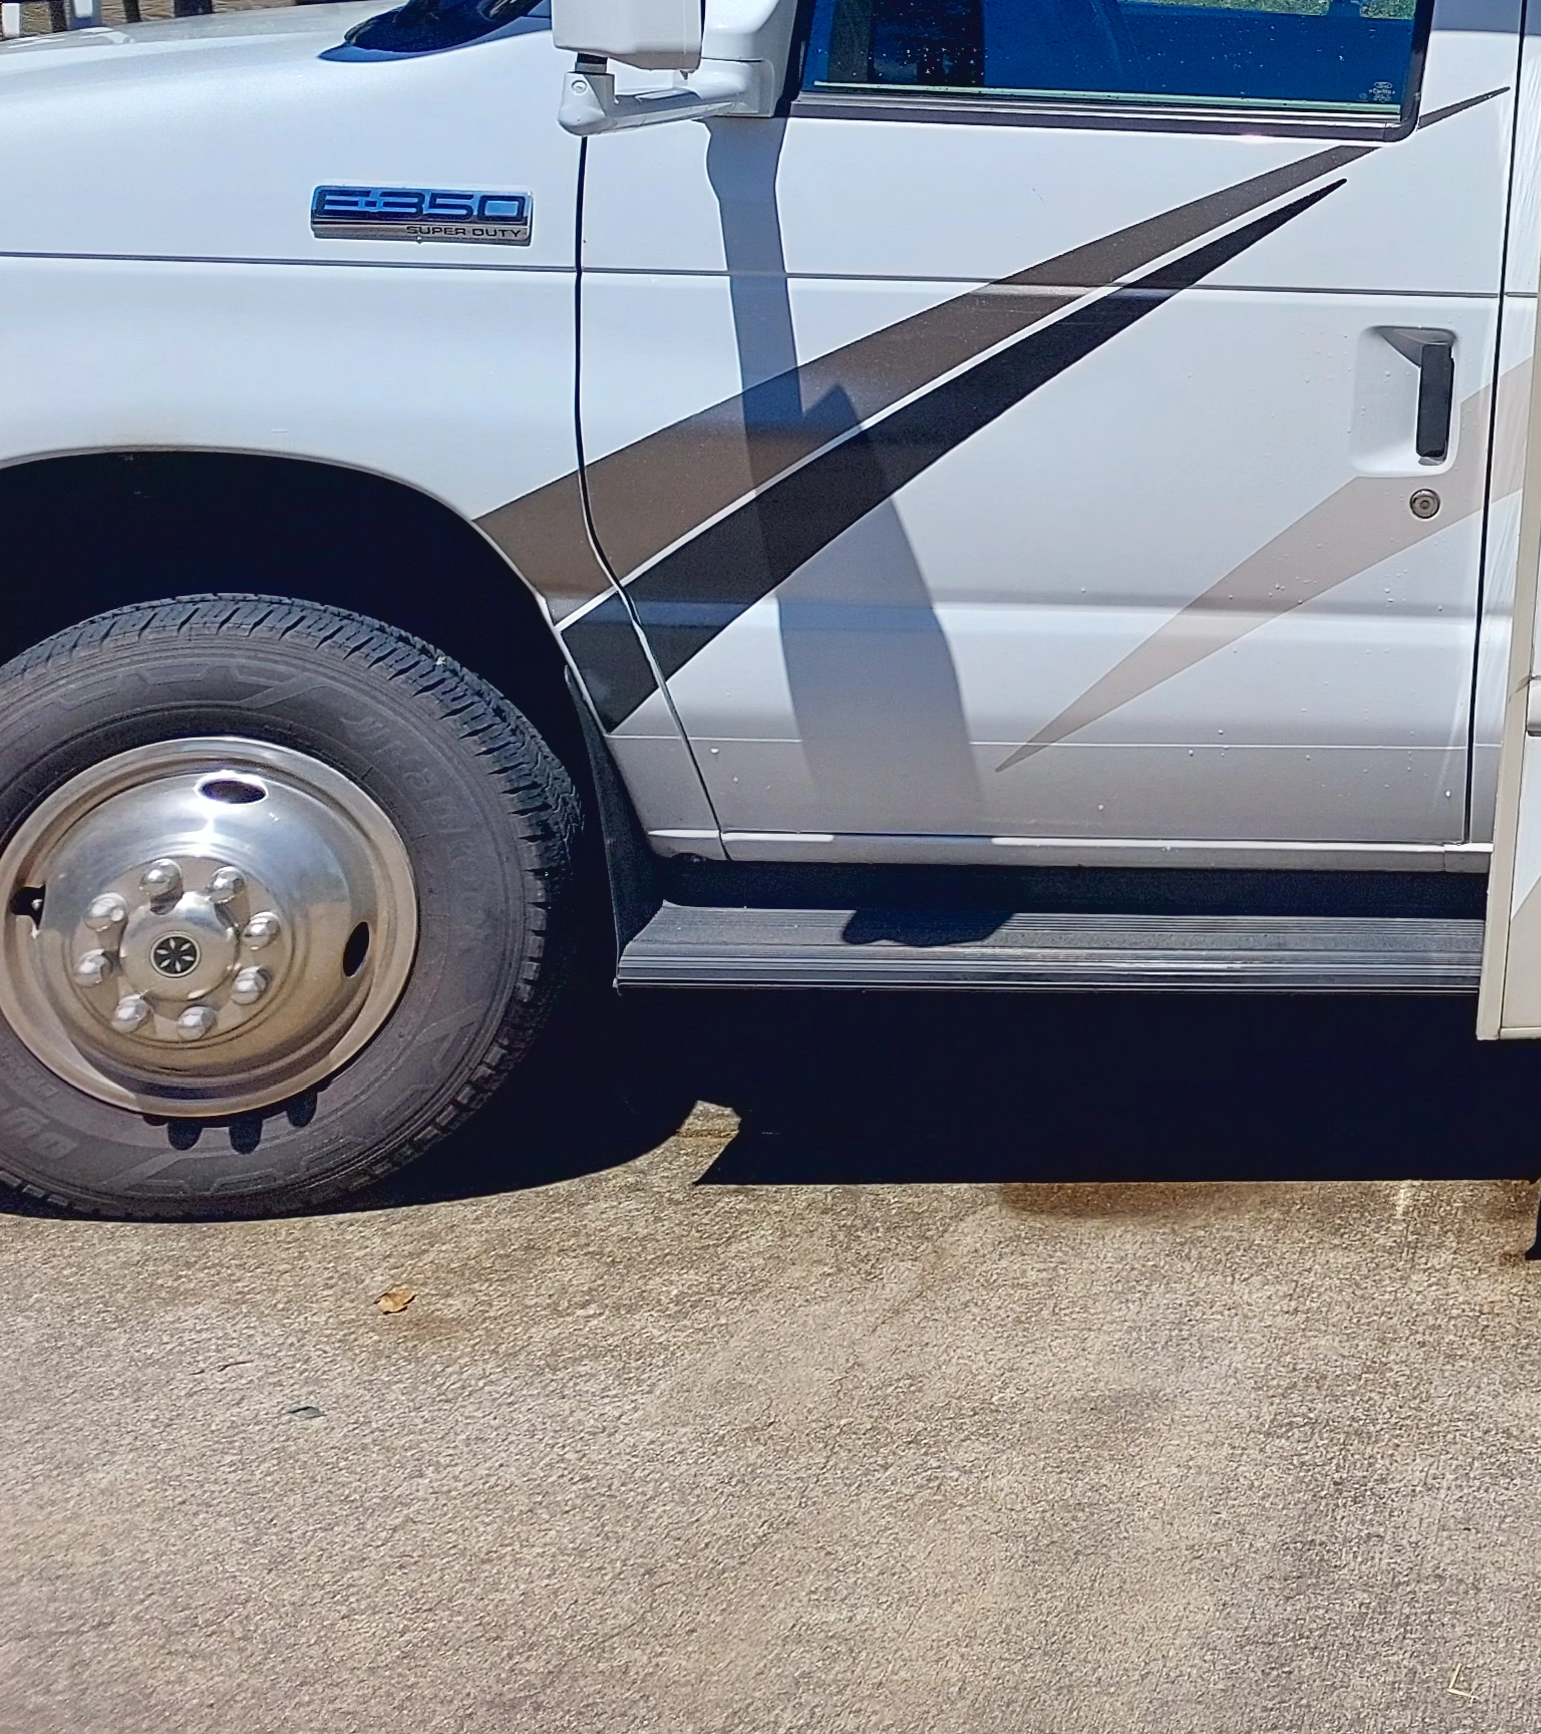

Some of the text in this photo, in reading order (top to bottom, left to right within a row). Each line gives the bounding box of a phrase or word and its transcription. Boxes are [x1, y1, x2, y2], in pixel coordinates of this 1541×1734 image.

[314, 188, 527, 223] E-350
[406, 225, 522, 238] SUPER DUTY
